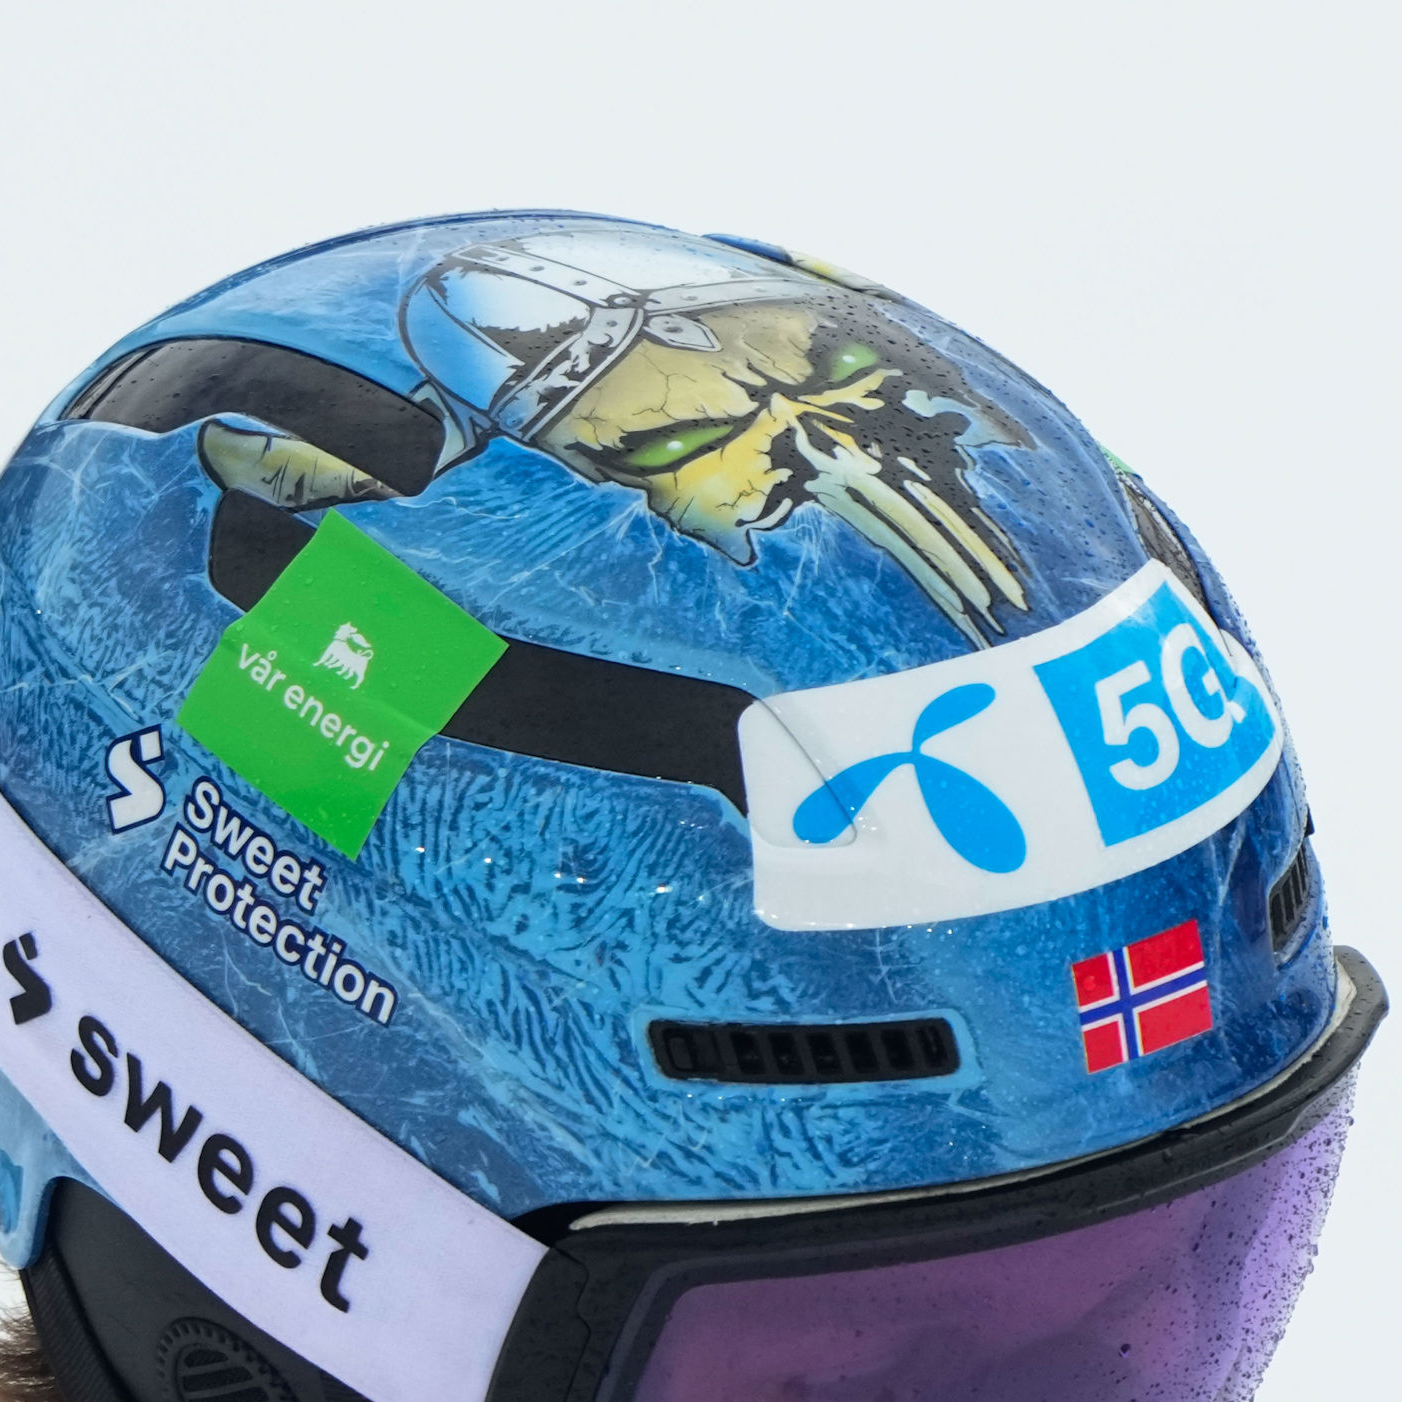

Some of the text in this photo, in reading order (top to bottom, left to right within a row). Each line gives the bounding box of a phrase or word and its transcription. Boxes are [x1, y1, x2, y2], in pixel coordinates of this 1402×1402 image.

[238, 641, 389, 771] vår energi
[1094, 622, 1247, 791] 5G
[164, 829, 398, 1026] Protection
[185, 779, 325, 911] Sweet
[70, 1014, 370, 1313] sweet
